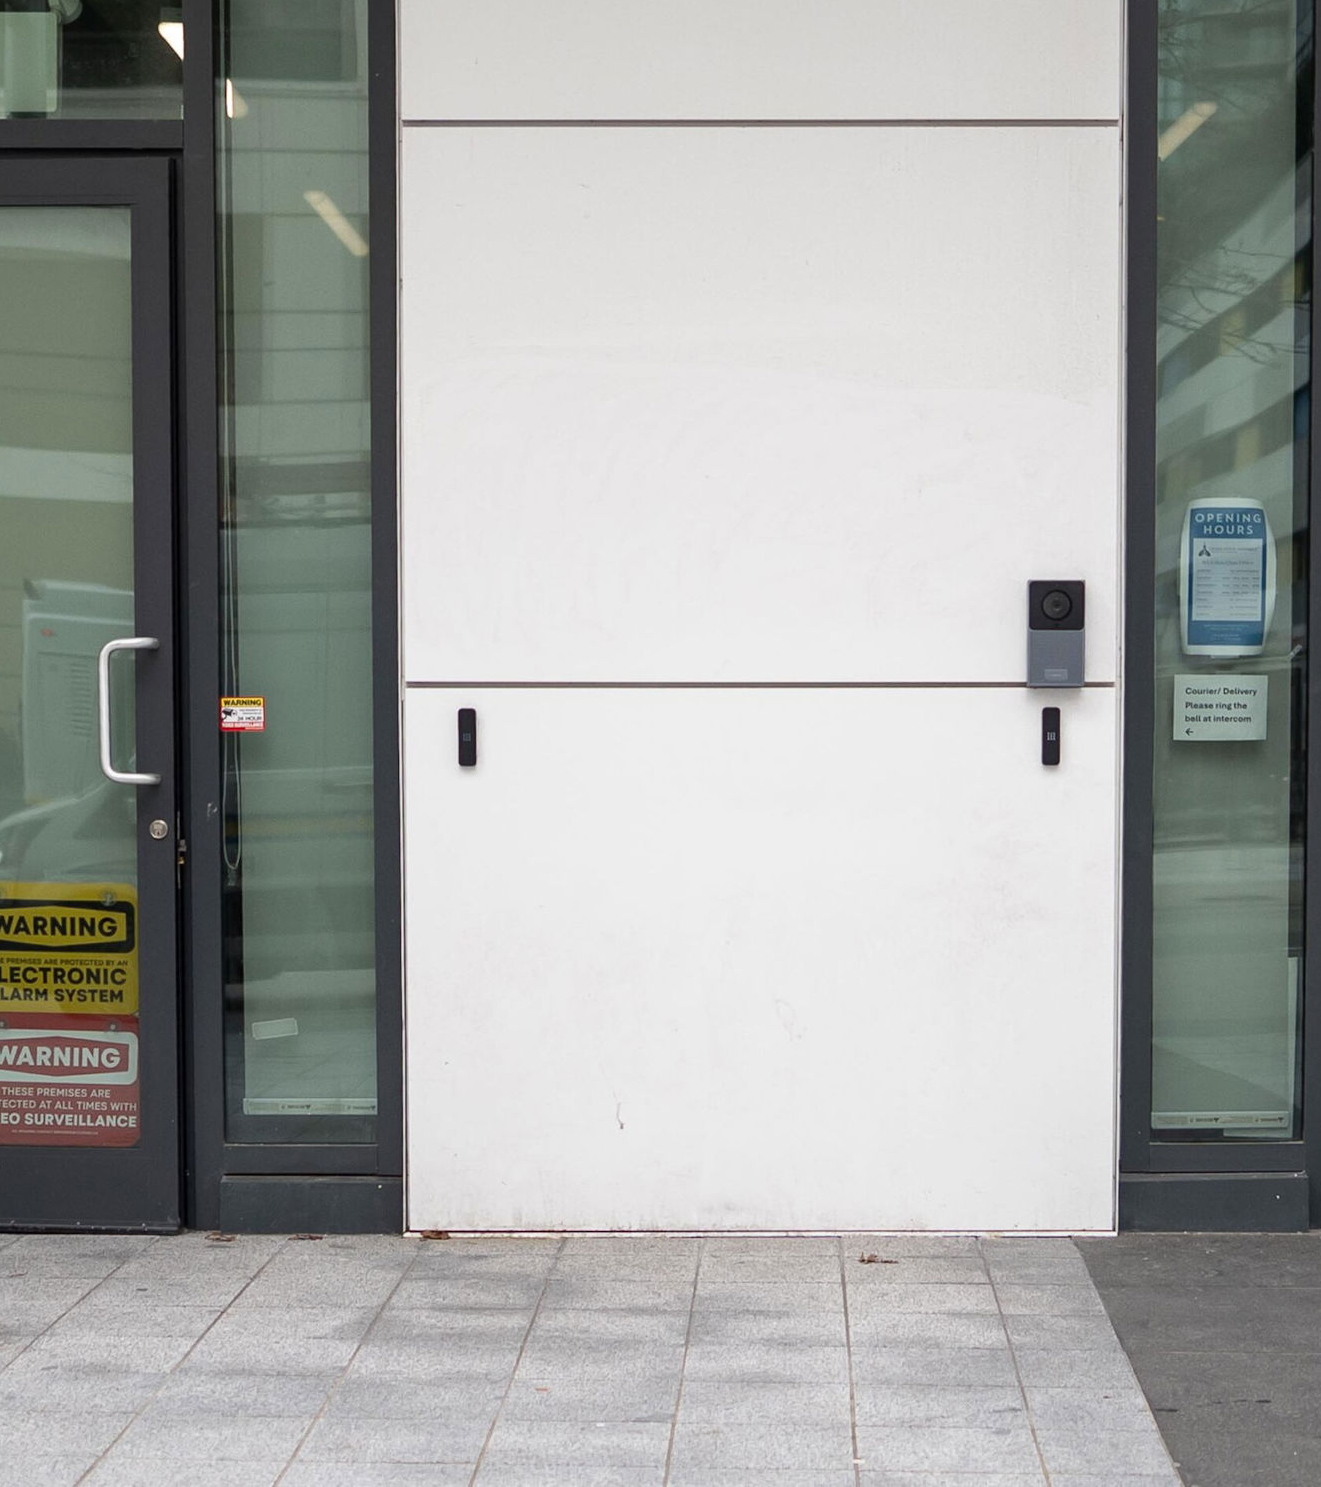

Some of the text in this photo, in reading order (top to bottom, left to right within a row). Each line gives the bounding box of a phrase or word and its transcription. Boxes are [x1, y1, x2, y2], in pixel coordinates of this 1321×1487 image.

[1195, 513, 1261, 523] OPENING
[1204, 525, 1254, 534] HOURS
[1185, 687, 1257, 696] Courier/ Delivery
[1234, 702, 1247, 710] the
[54, 988, 123, 1003] SYSTEM
[2, 1087, 110, 1098] THESE PREMISES ARE
[38, 1100, 52, 1109] AT
[55, 1100, 74, 1110] ALL
[75, 1101, 108, 1111] TIMES
[110, 1101, 136, 1111] WITH
[24, 1113, 136, 1127] SURVEILLANCE
